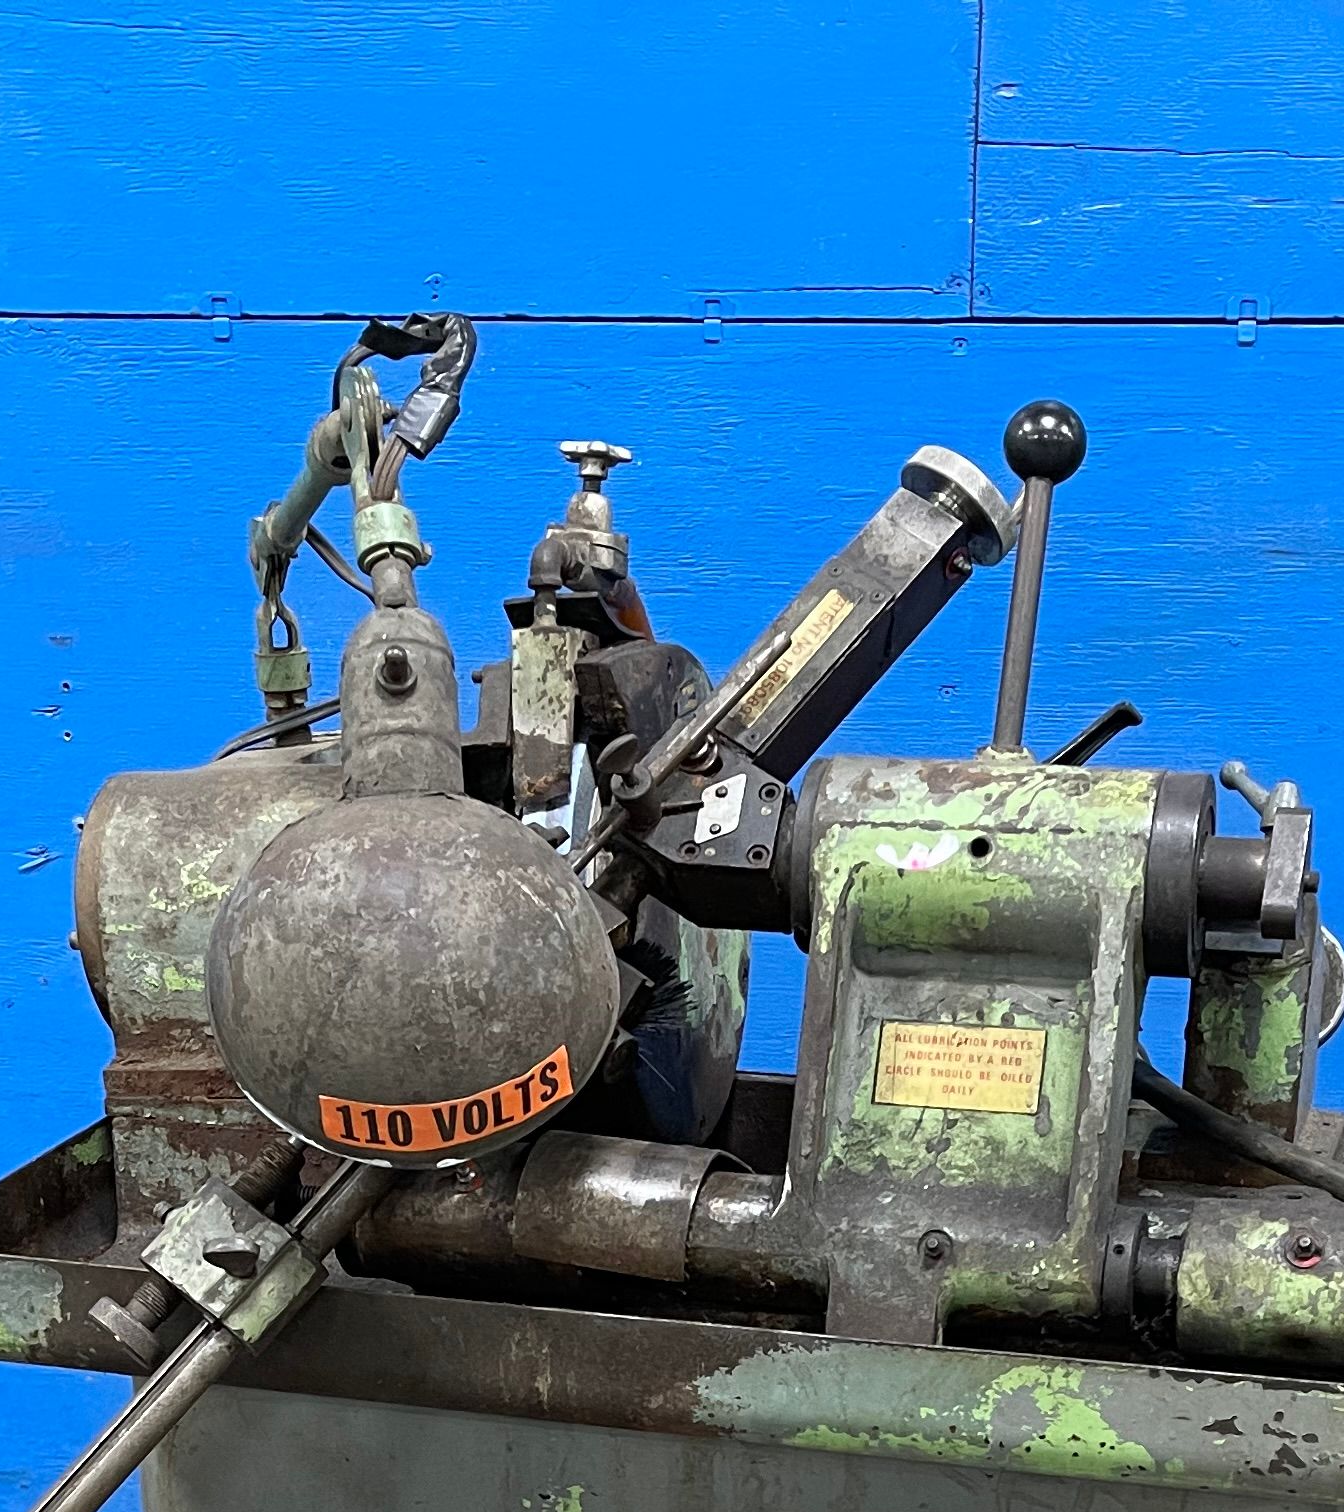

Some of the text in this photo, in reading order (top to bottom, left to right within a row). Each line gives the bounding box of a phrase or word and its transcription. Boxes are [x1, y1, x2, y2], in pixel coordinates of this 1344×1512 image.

[808, 595, 846, 637] ATENT
[895, 1033, 913, 1043] ALL
[993, 1039, 1033, 1051] POINTS
[905, 1050, 1022, 1067] INDICATED BY A RED
[885, 1065, 1033, 1084] CIRCLE SHOULD BE OILED
[942, 1084, 975, 1096] DAILY
[335, 1061, 559, 1147] 110 VOLTS
